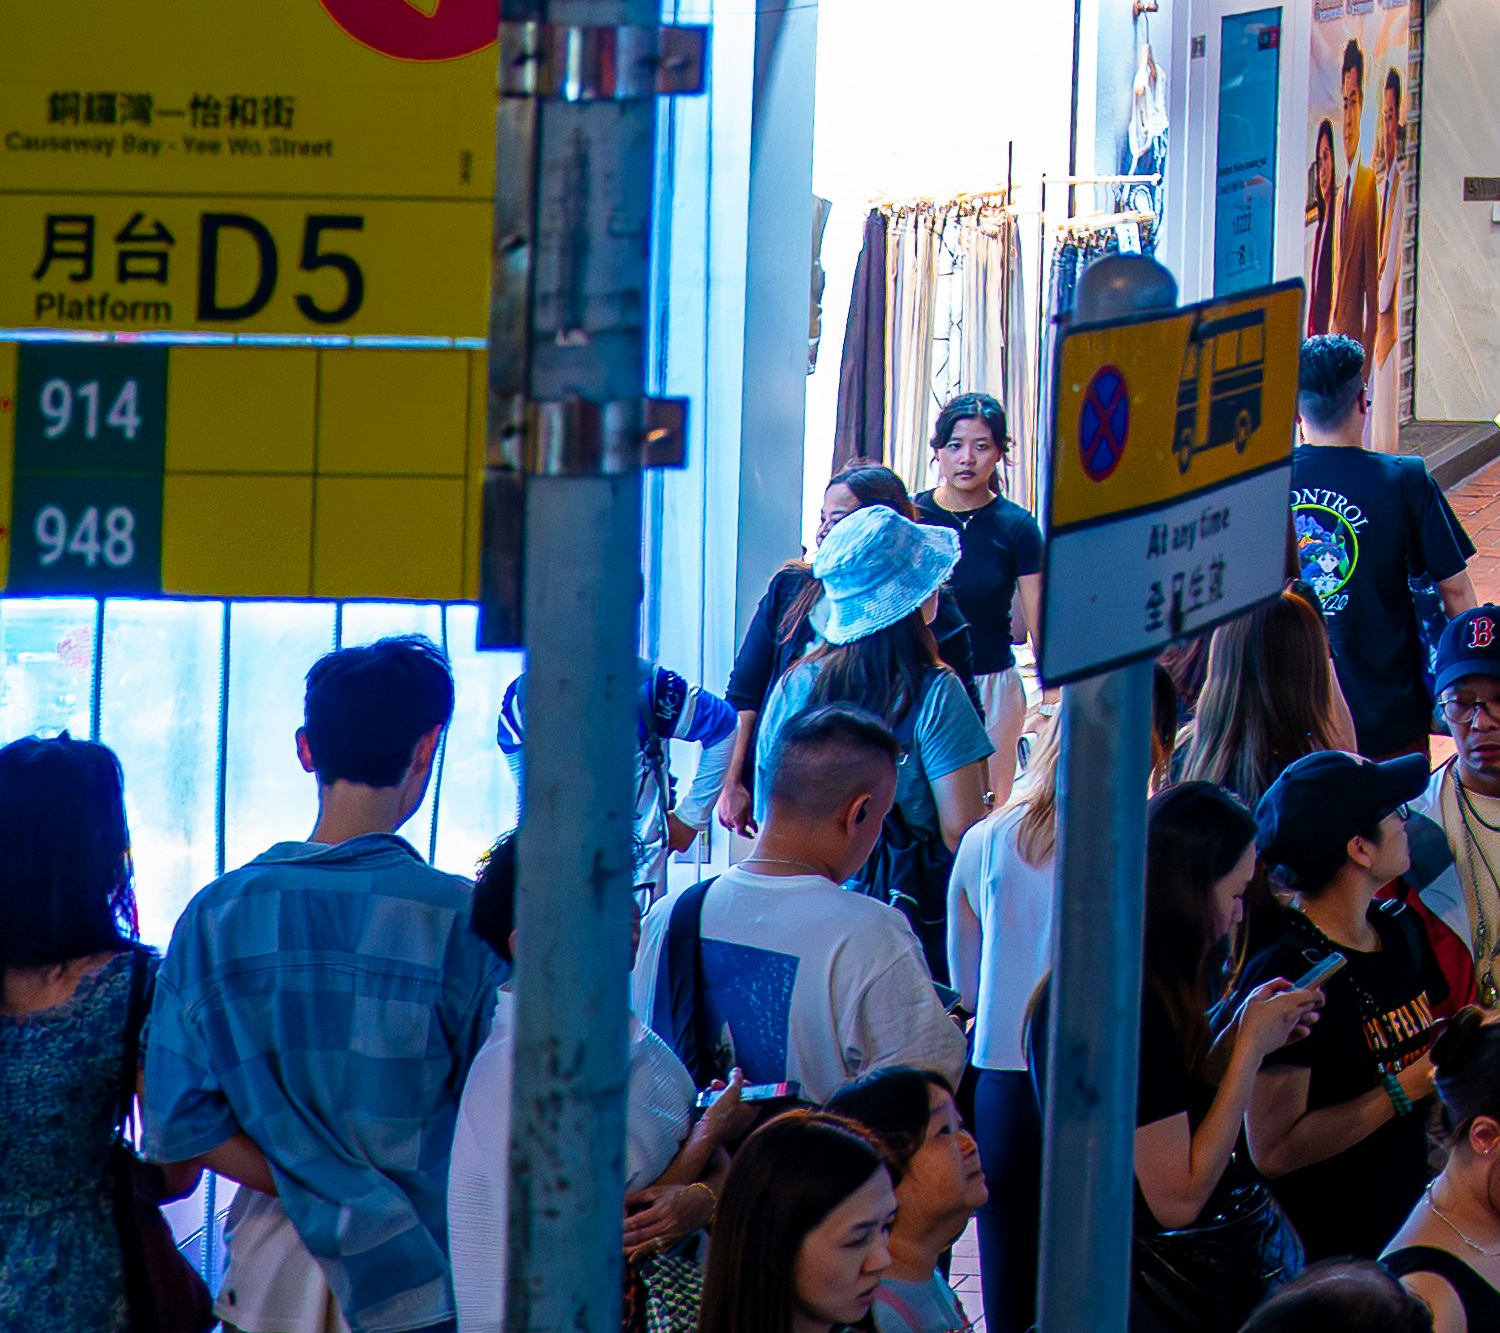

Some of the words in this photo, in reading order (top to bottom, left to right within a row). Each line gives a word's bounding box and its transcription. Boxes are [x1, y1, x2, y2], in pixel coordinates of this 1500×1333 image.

[5, 133, 115, 157] Causeway
[122, 134, 162, 157] Bay
[184, 136, 222, 157] Yee
[228, 136, 261, 156] Wo
[269, 136, 334, 158] Street
[33, 212, 176, 284] 月台
[200, 213, 366, 325] D5
[35, 293, 172, 325] Platform
[40, 379, 142, 441] 914
[35, 507, 135, 567] 948
[1147, 524, 1168, 559] At
[1172, 519, 1198, 551] any
[1199, 505, 1230, 533] time
[1467, 616, 1496, 648] B
